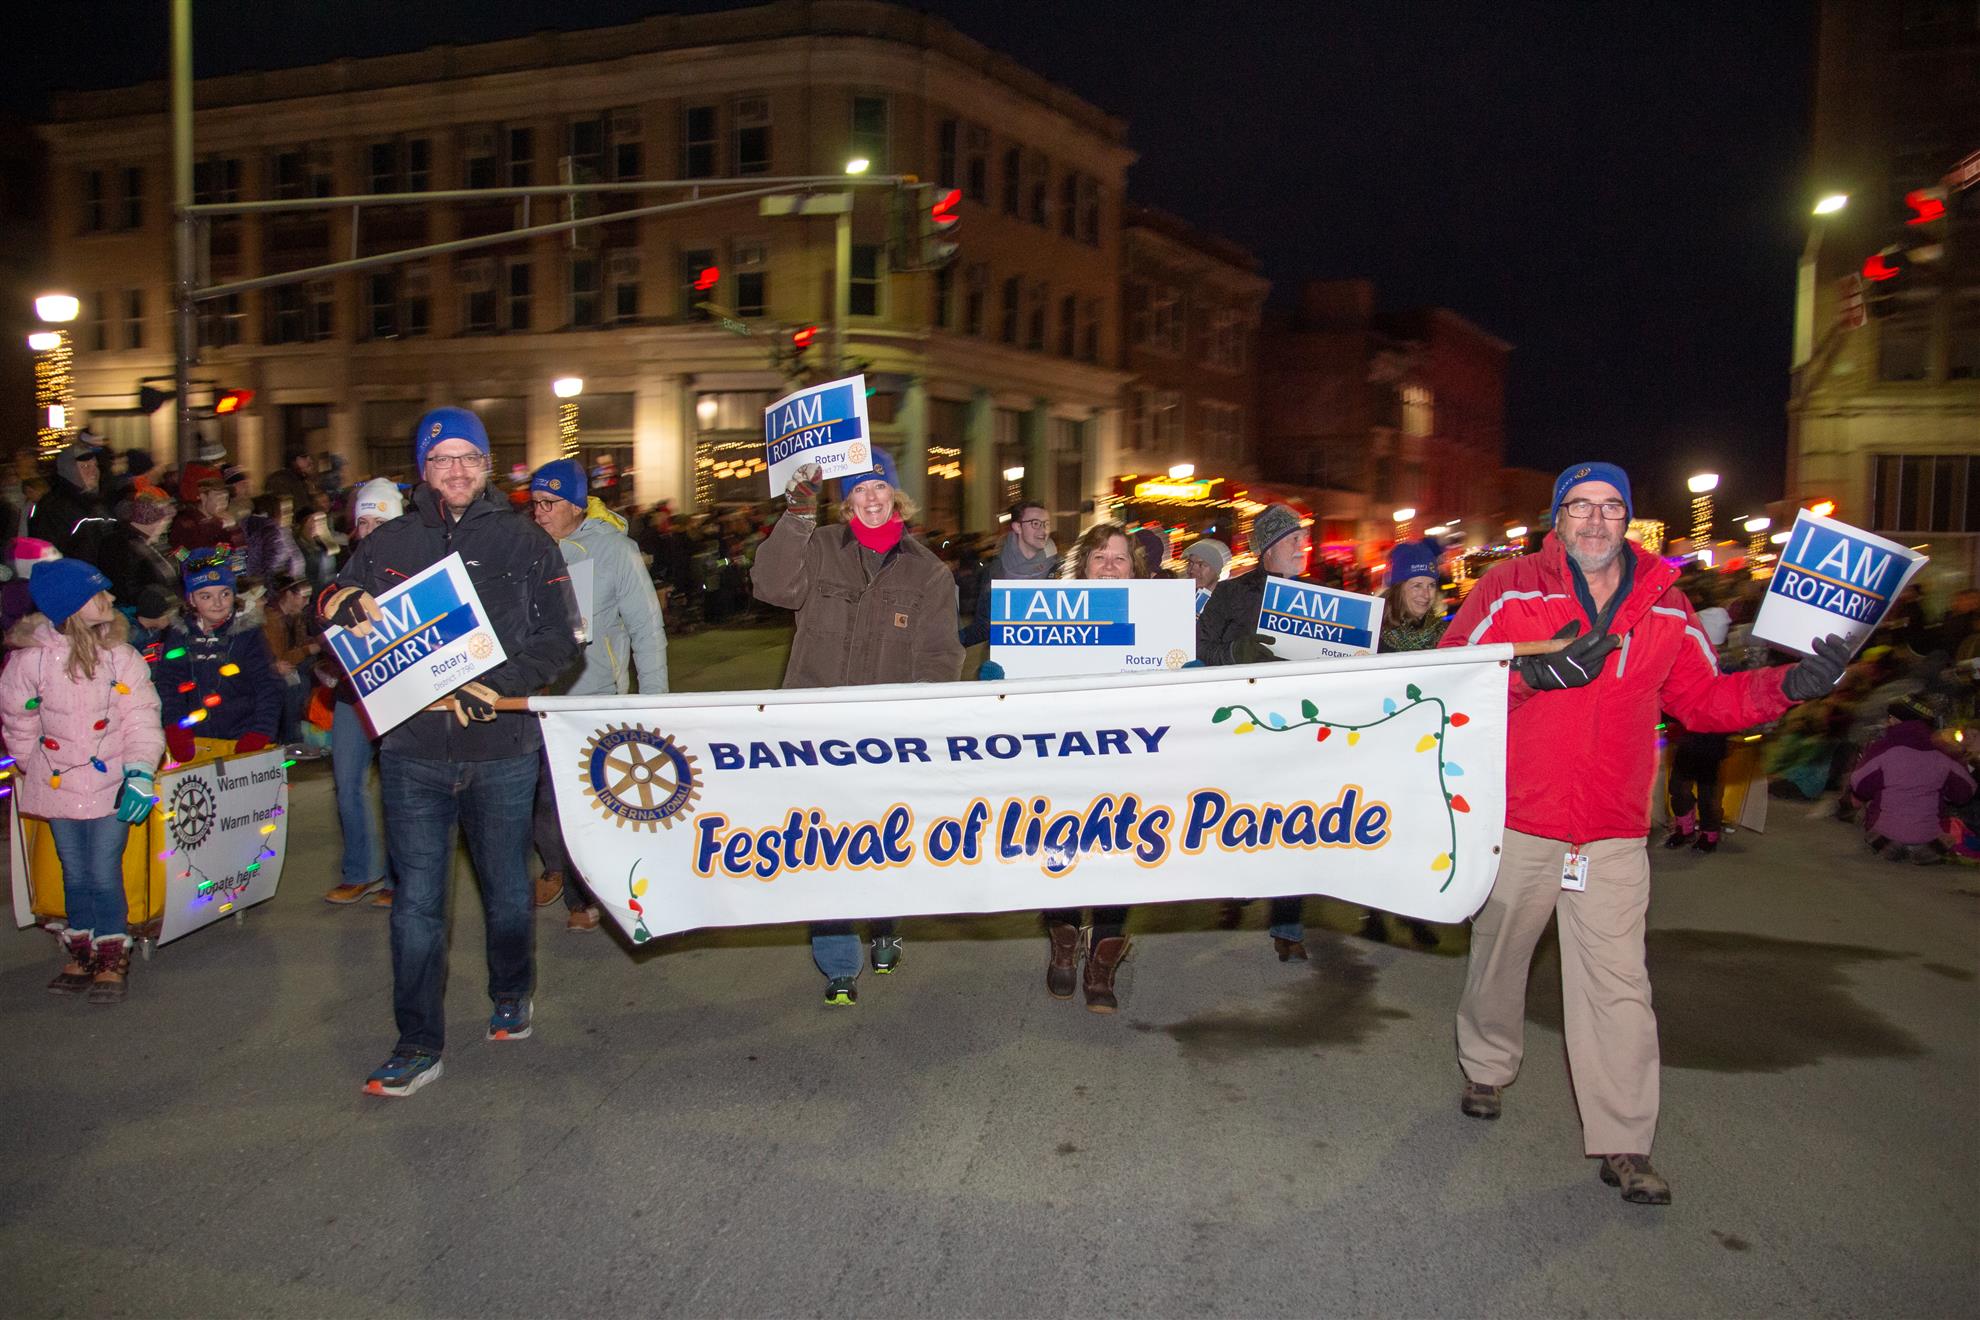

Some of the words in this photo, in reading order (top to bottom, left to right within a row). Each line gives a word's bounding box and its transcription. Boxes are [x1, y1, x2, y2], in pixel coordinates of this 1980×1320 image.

[772, 413, 777, 439] I
[782, 394, 823, 435] AM
[773, 425, 832, 462] ROTARY!
[815, 452, 846, 465] Rotary
[1795, 527, 1816, 564] I
[1815, 538, 1892, 591] AM
[1004, 590, 1011, 620] I
[1024, 590, 1089, 620] AM
[1272, 585, 1281, 610] I
[1286, 590, 1340, 622] AM
[1781, 571, 1877, 621] ROTARY!
[340, 633, 361, 665] I
[364, 592, 422, 656] AM
[1003, 626, 1099, 644] ROTARY!
[1267, 614, 1343, 642] ROTARY!
[360, 625, 444, 691] ROTARY!
[430, 650, 469, 678] Rotary
[1125, 654, 1163, 667] Rotary
[433, 676, 457, 692] District
[455, 663, 476, 681] 7790
[603, 730, 661, 748] ROTARY
[708, 737, 932, 770] BANGOR
[946, 725, 1171, 762] ROTARY
[217, 775, 249, 793] Warm
[600, 787, 690, 820] INTERNATIONAL
[220, 812, 254, 832] Warm
[697, 805, 913, 878] Festival
[927, 800, 989, 862] of
[1000, 795, 1170, 873] Lights
[1183, 788, 1388, 850] Parade
